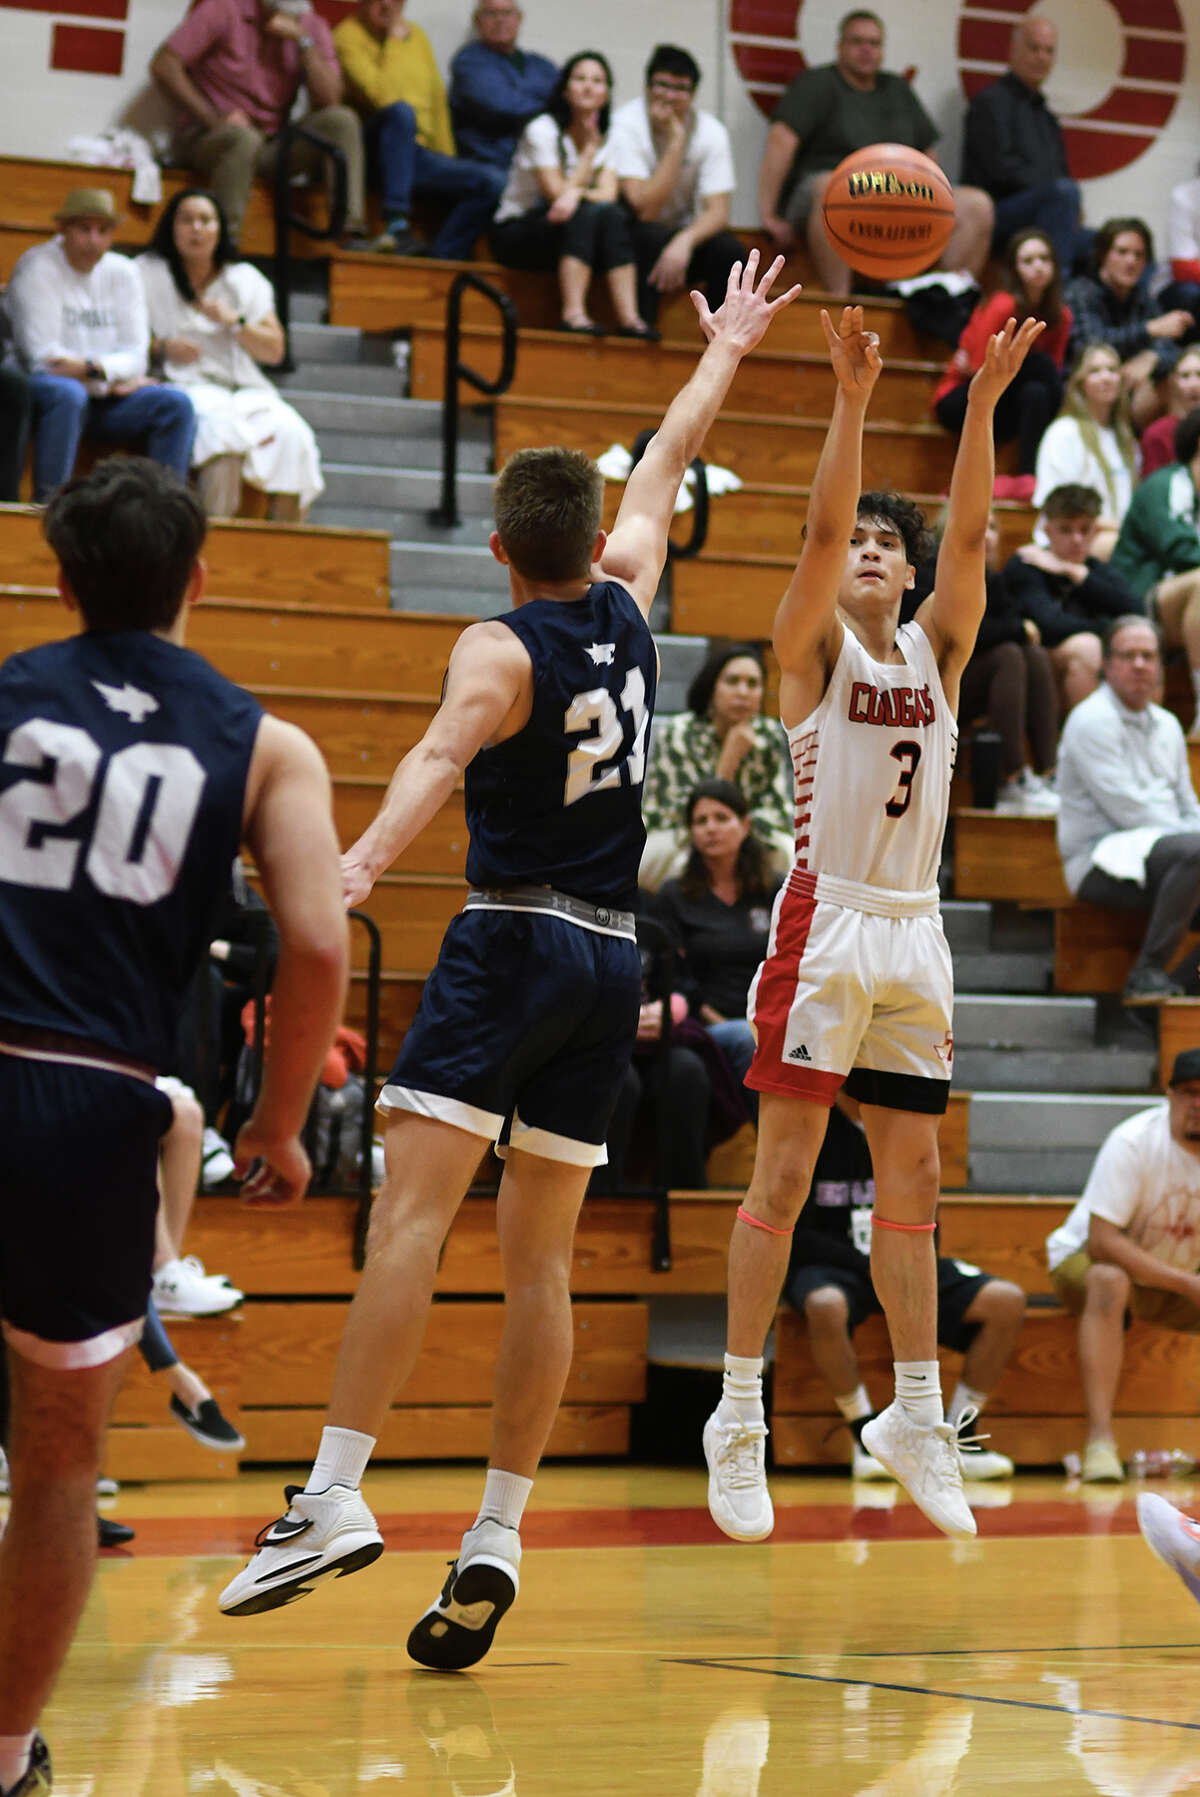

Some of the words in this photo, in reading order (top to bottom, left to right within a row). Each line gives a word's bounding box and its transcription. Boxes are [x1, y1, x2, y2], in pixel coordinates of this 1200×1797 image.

[563, 665, 650, 807] 21
[885, 740, 922, 818] 3
[0, 717, 207, 906] 20
